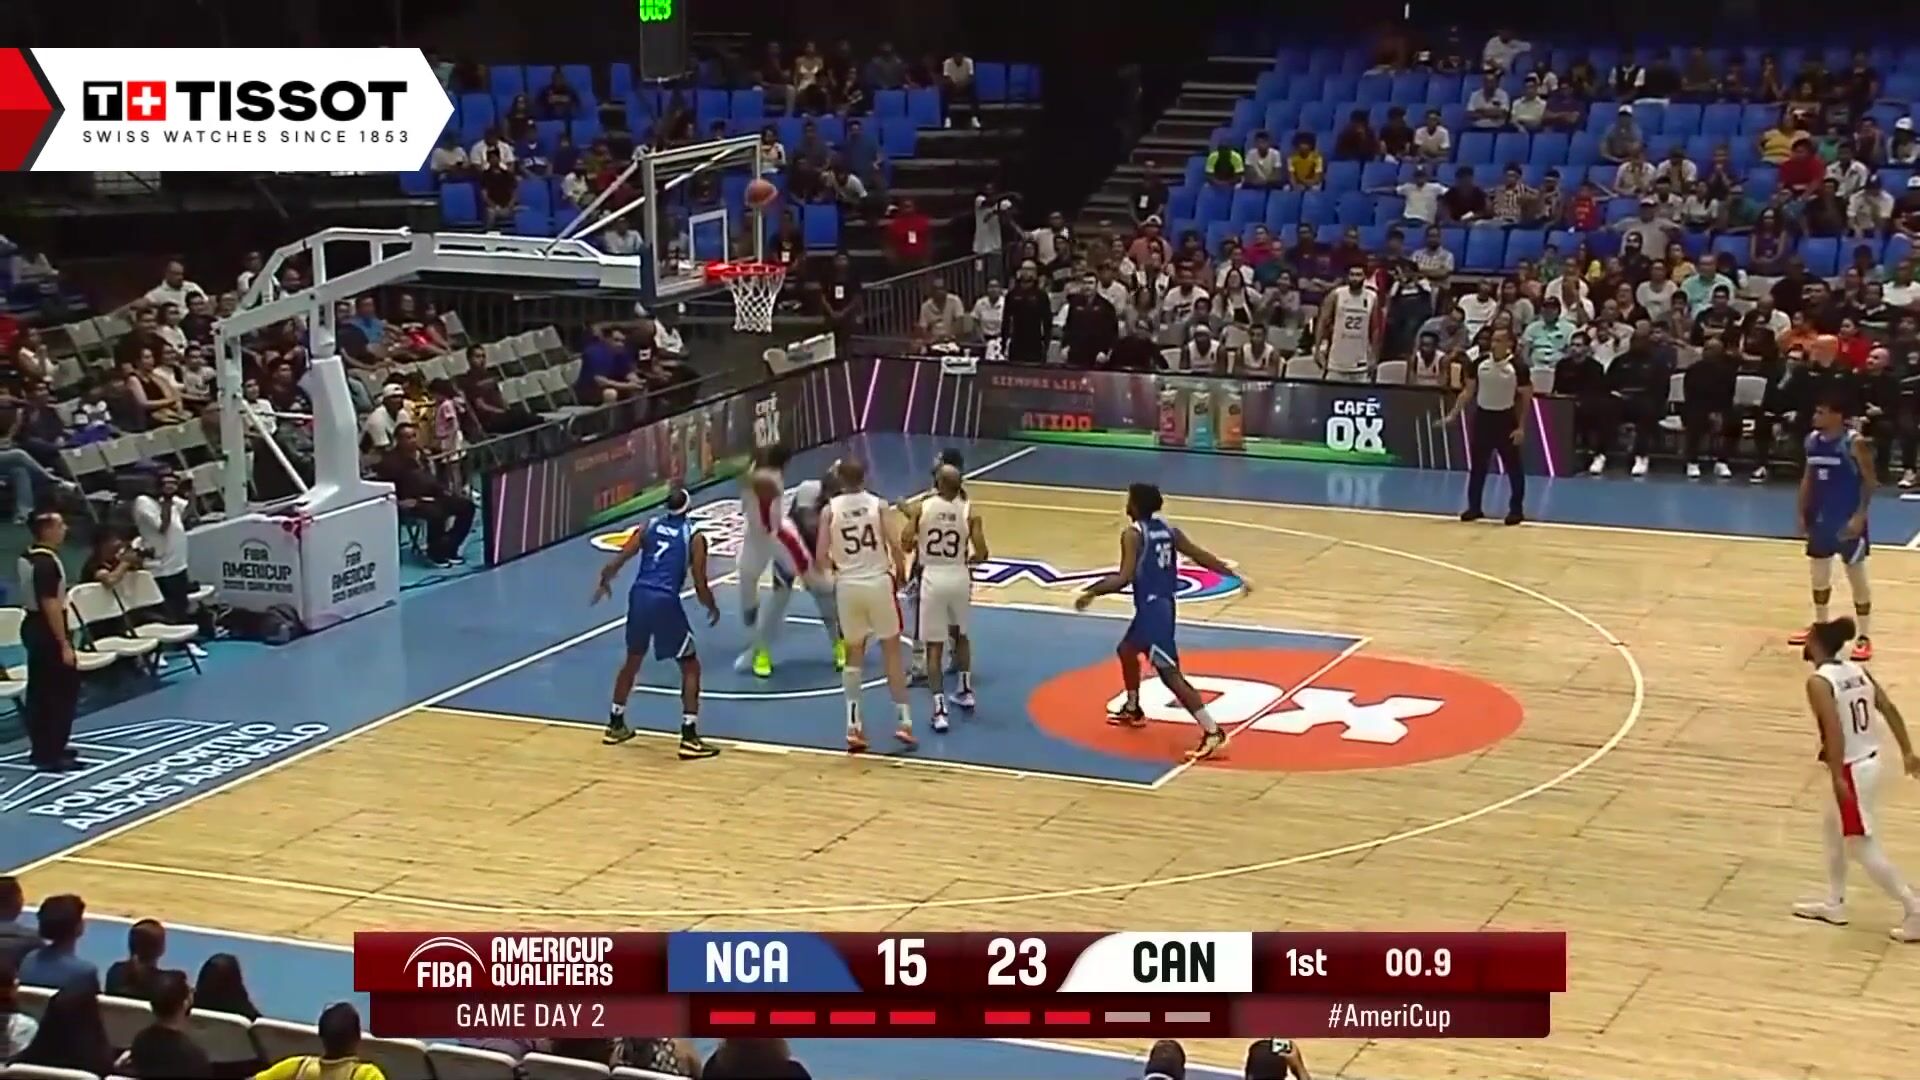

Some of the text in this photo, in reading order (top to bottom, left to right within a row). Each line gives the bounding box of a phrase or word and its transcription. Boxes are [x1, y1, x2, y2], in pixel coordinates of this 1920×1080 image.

[1345, 316, 1363, 330] 22
[1333, 397, 1381, 416] CAFÉ
[1326, 416, 1387, 454] OX
[655, 541, 671, 562] 7
[841, 523, 878, 555] 54
[926, 528, 961, 558] 23
[222, 562, 292, 581] AMERICUP
[1849, 697, 1869, 735] 10
[28, 723, 277, 816] POLIDEPORTIVO
[62, 723, 329, 832] ALEXIS ARGUELLO
